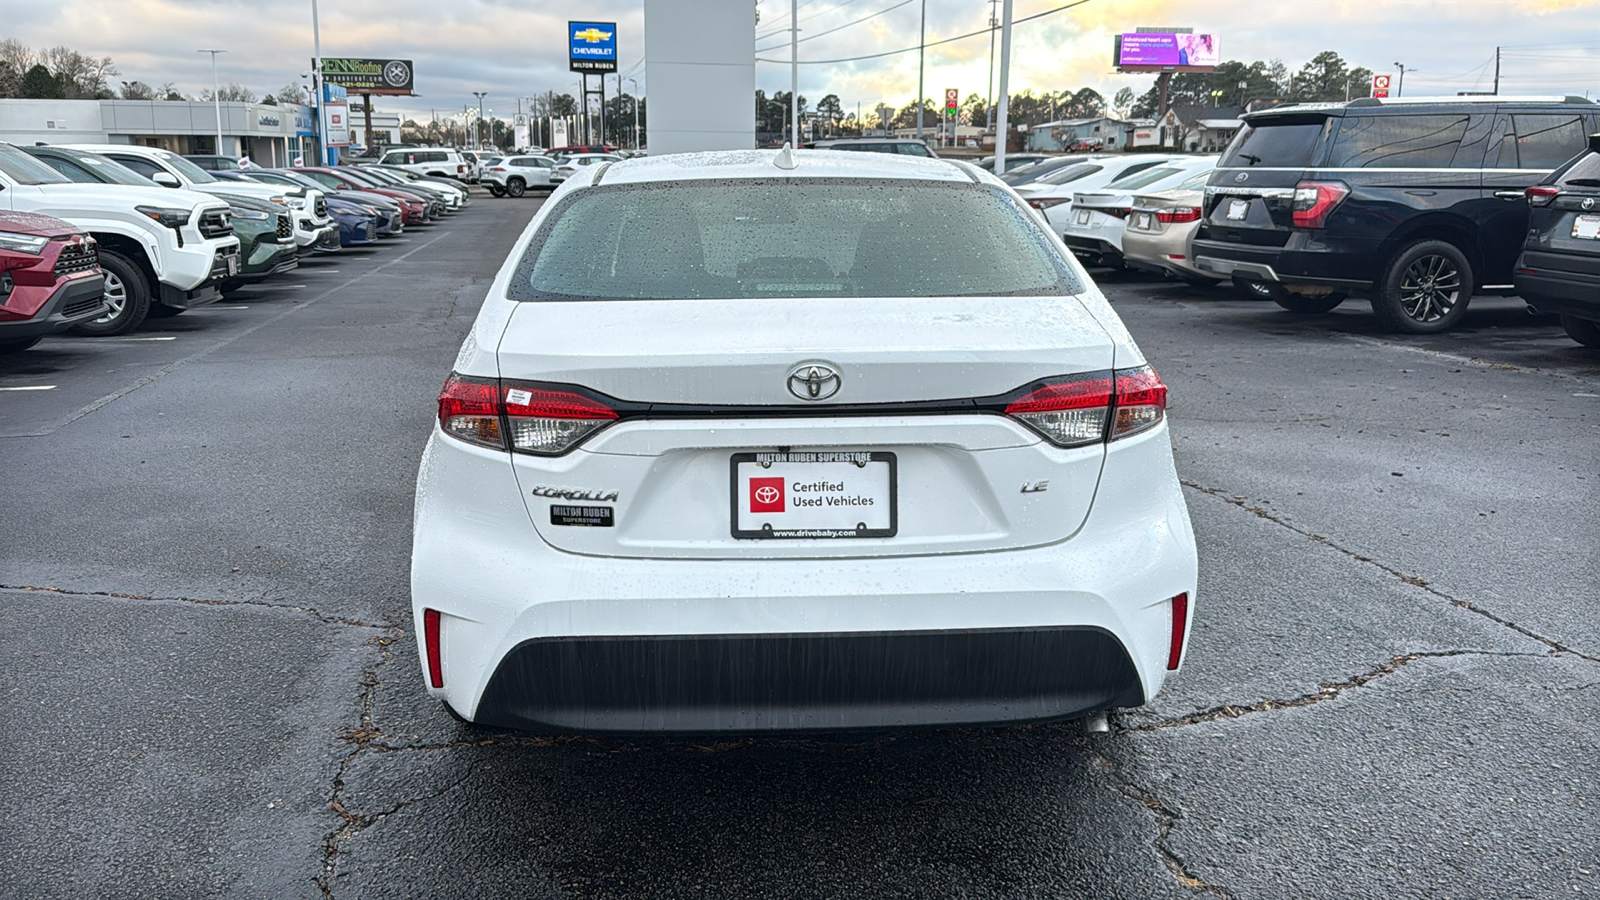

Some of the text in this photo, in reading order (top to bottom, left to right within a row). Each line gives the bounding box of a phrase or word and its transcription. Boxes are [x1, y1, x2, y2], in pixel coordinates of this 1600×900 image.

[573, 47, 613, 55] CHEVROLET
[354, 61, 382, 75] Roofing
[756, 452, 872, 462] MILTON RUBEN SUPERSTORE
[792, 482, 844, 492] Certified
[1020, 480, 1050, 493] LE
[532, 485, 619, 502] COROLLA
[793, 496, 874, 507] Used Vehicles
[553, 506, 611, 517] MILTON RUBEN
[773, 530, 857, 538] www.drivebaby.com
